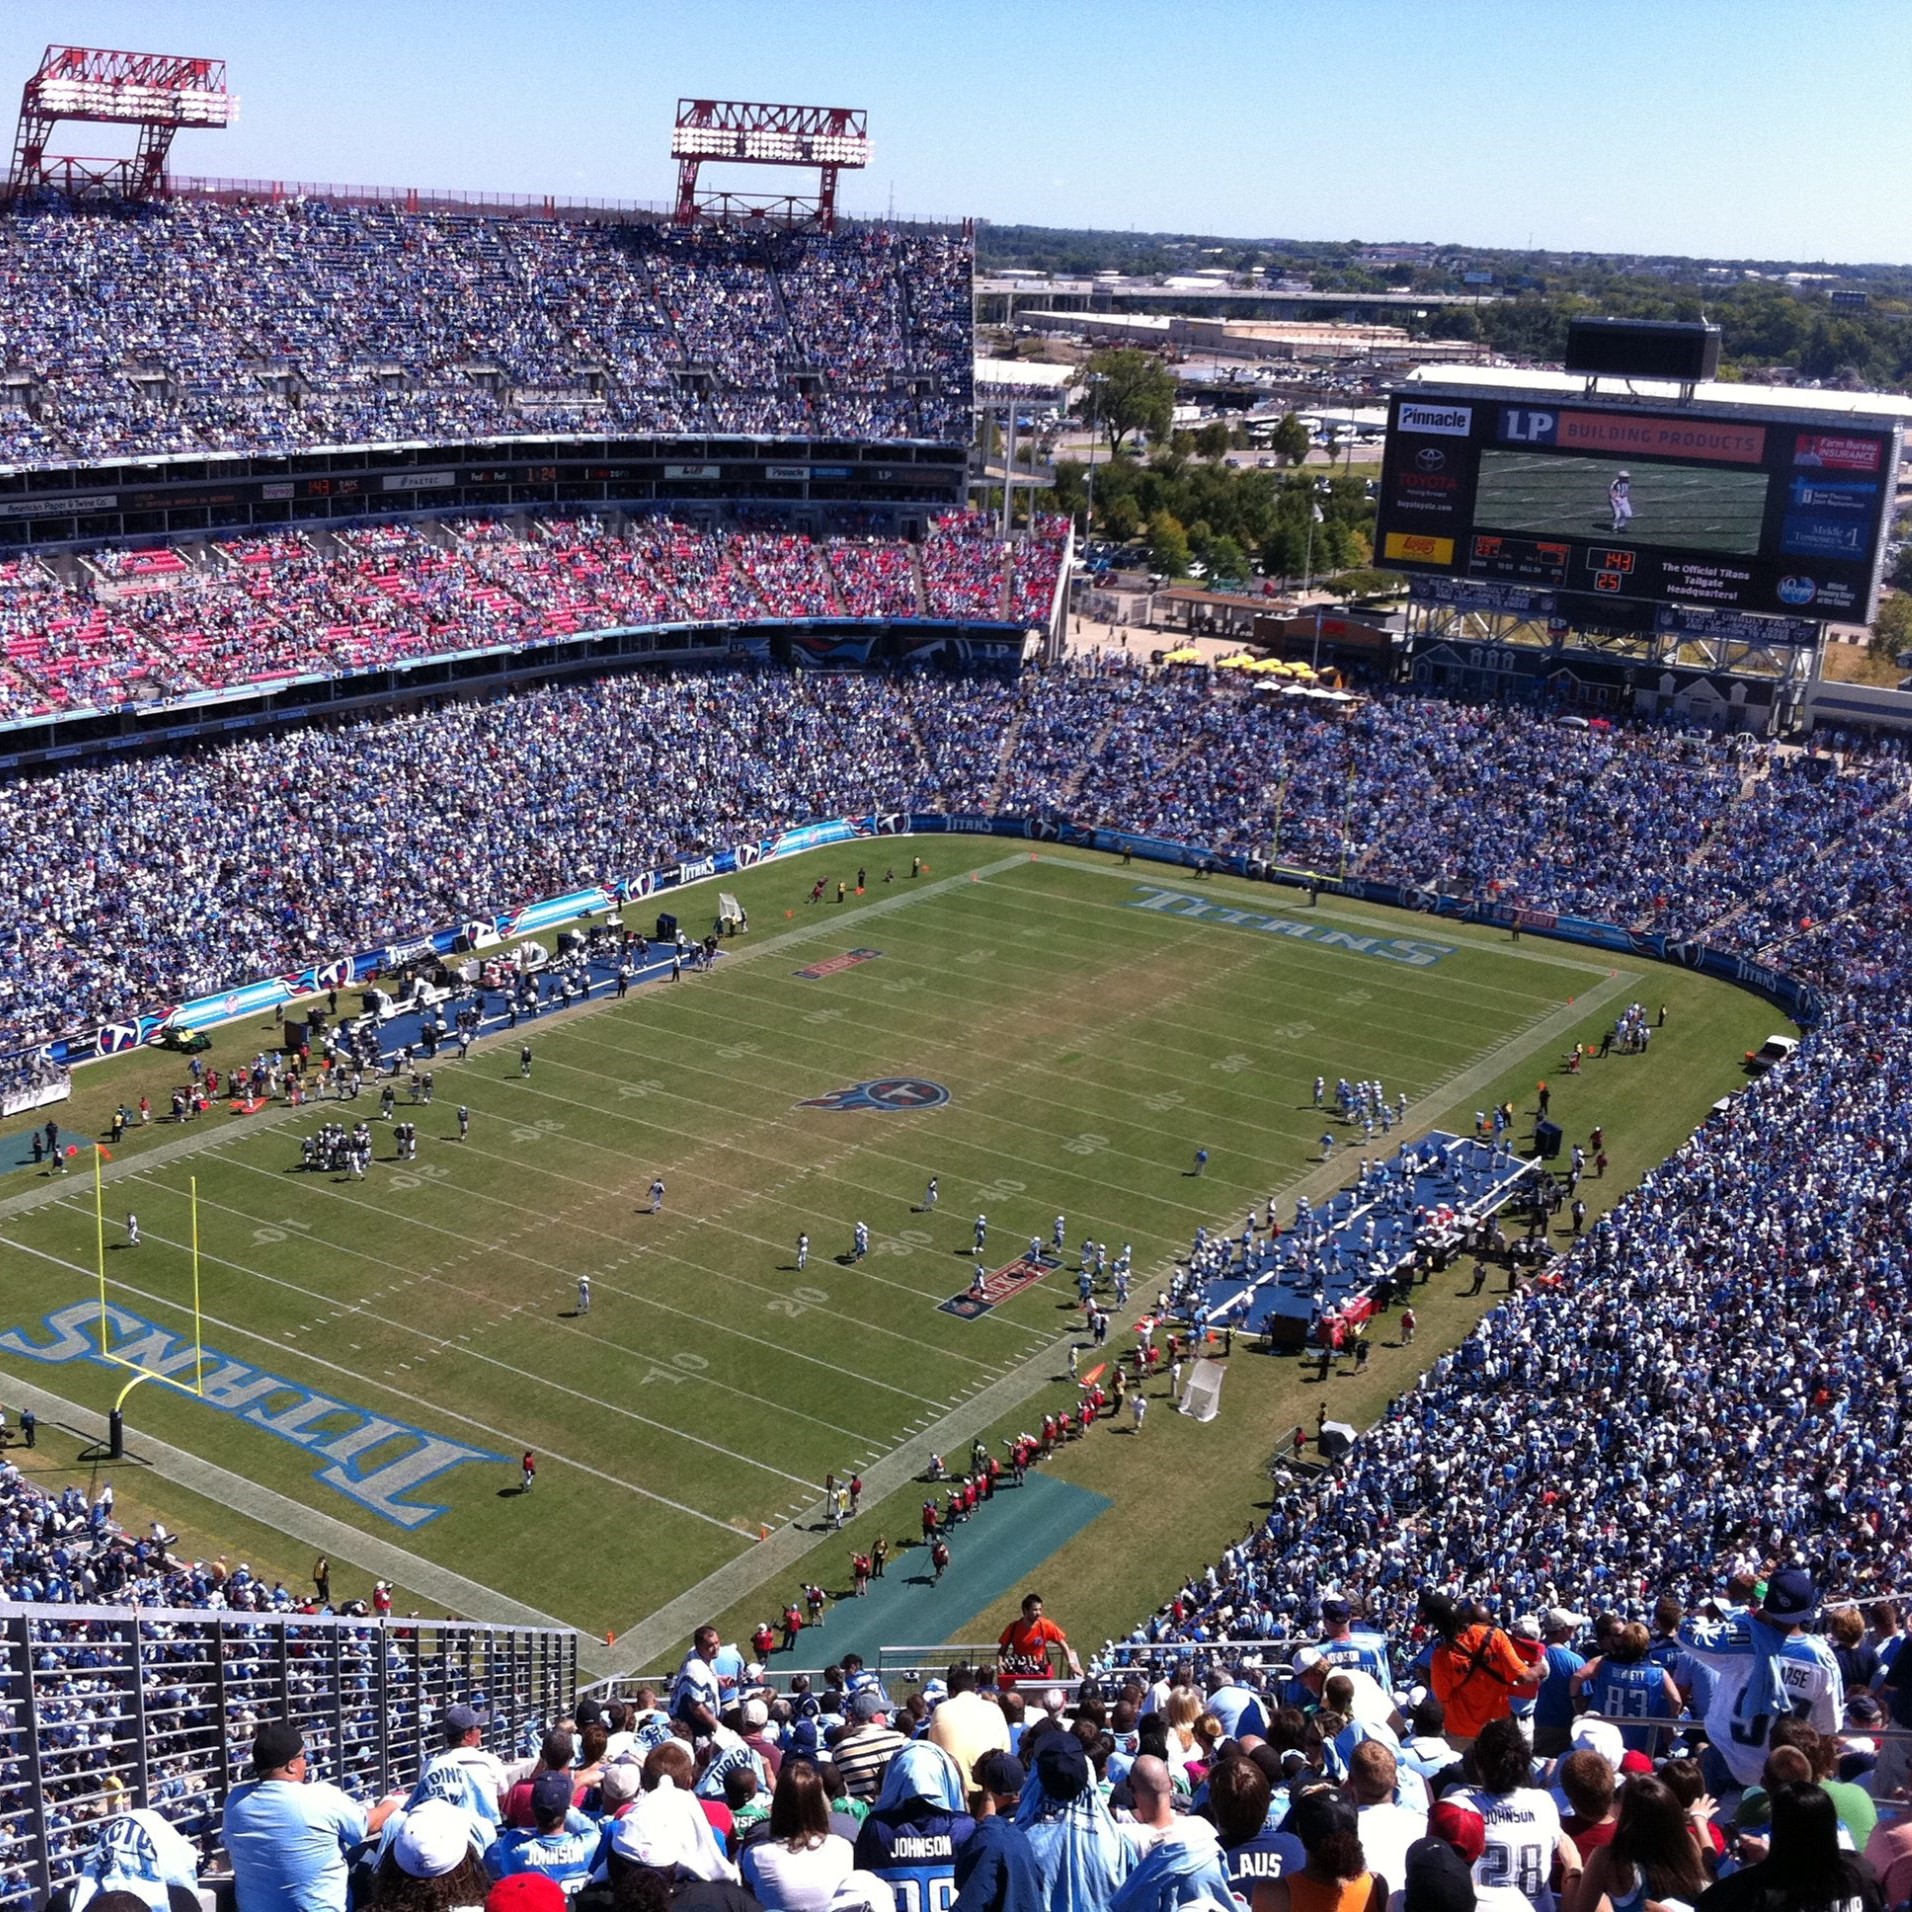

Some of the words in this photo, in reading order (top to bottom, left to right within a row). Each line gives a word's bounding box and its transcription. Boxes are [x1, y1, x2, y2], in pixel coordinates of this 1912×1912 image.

[1402, 408, 1467, 428] Pinnacle
[1506, 410, 1554, 441] LP
[1567, 423, 1651, 443] BUILDING
[1658, 430, 1755, 451] PRODUCTS
[1399, 472, 1457, 490] TOYOTA
[1598, 574, 1619, 590] 25
[1662, 562, 1680, 573] The
[1682, 564, 1718, 577] Official
[1684, 576, 1725, 588] Tailgate
[1666, 584, 1738, 600] Headquarters!
[945, 813, 993, 832] TITANS
[1124, 886, 1457, 967] TITANS
[1736, 955, 1780, 993] TITANS
[252, 1217, 313, 1243] 10
[766, 1287, 830, 1318] 20
[639, 1352, 710, 1385] 10
[0, 1299, 500, 1530] TITANS
[1604, 1685, 1649, 1718] 83
[1483, 1809, 1537, 1825] JOHNSON
[524, 1847, 586, 1867] JOHNSON
[890, 1834, 953, 1859] JOHNSON
[1480, 1841, 1544, 1899] 28
